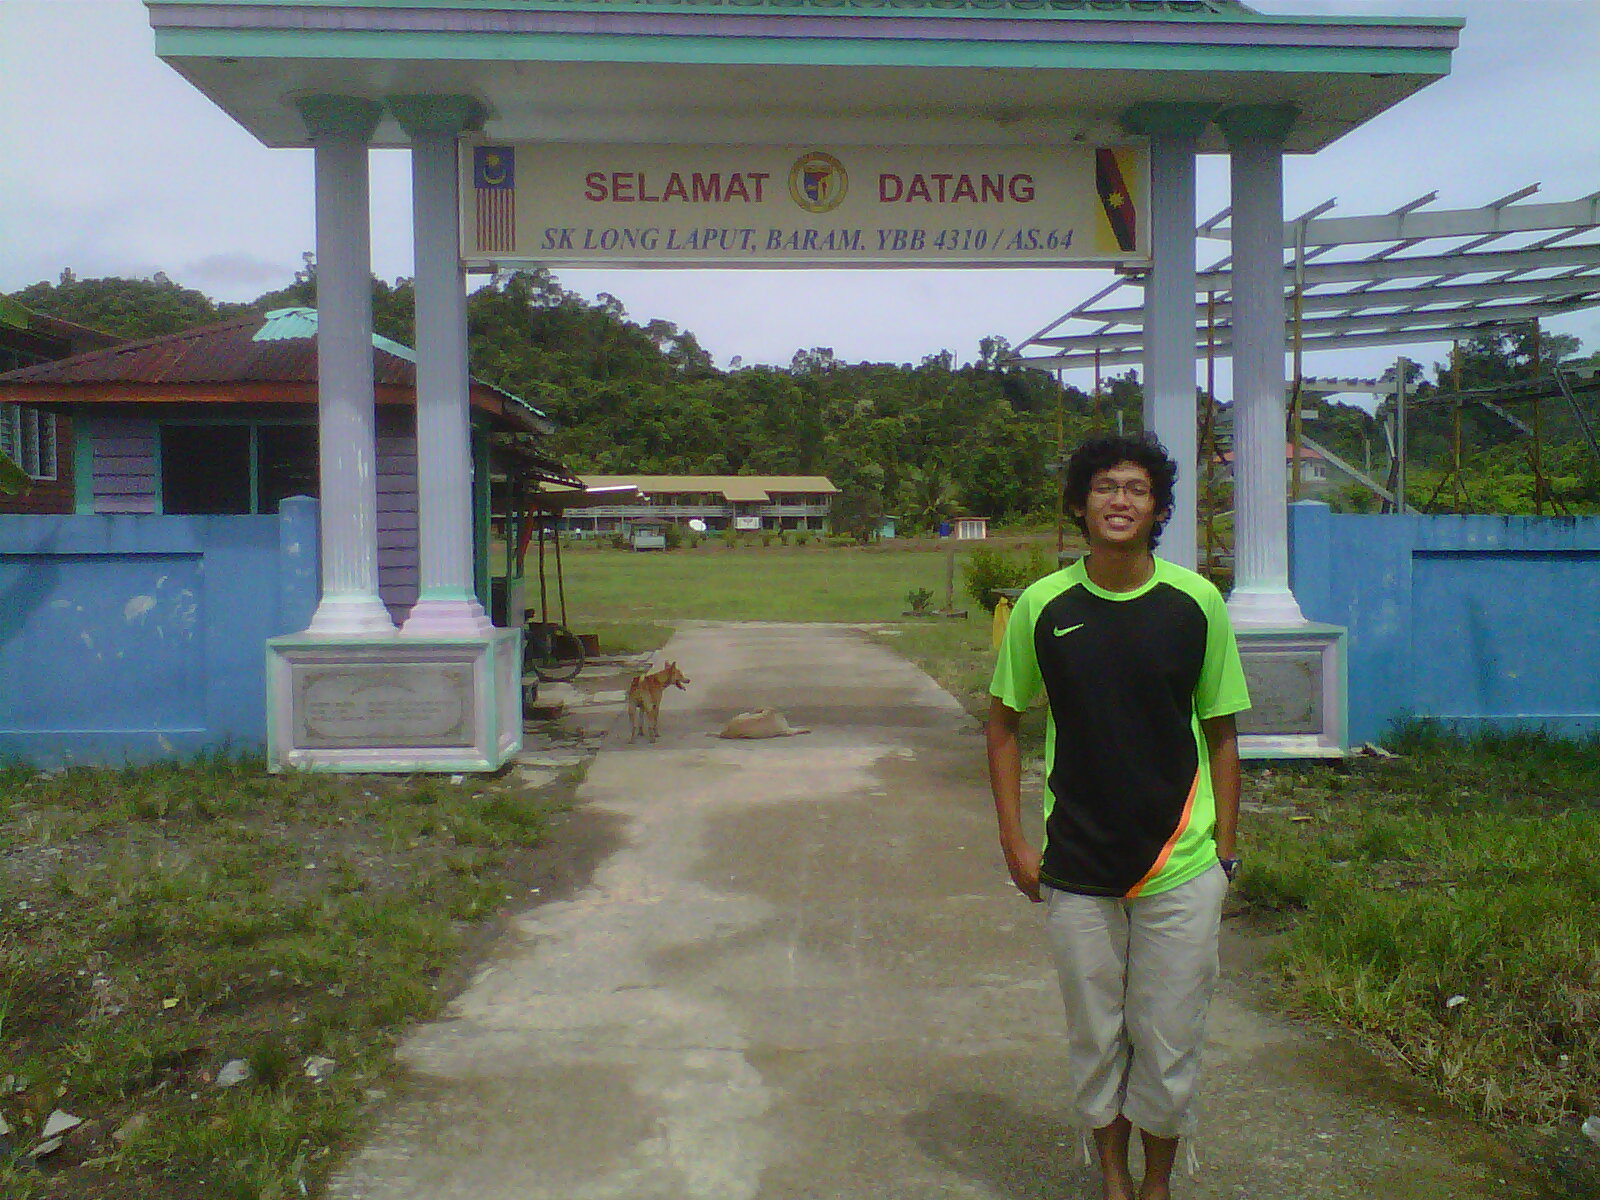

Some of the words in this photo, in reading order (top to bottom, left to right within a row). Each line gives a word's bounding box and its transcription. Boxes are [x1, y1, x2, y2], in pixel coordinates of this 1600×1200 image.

[586, 172, 769, 202] SELAMAT
[880, 174, 1035, 203] DATANG
[541, 227, 577, 251] SK
[584, 227, 659, 251] LONG
[667, 228, 757, 252] LAPUT,
[877, 229, 926, 251] YBB
